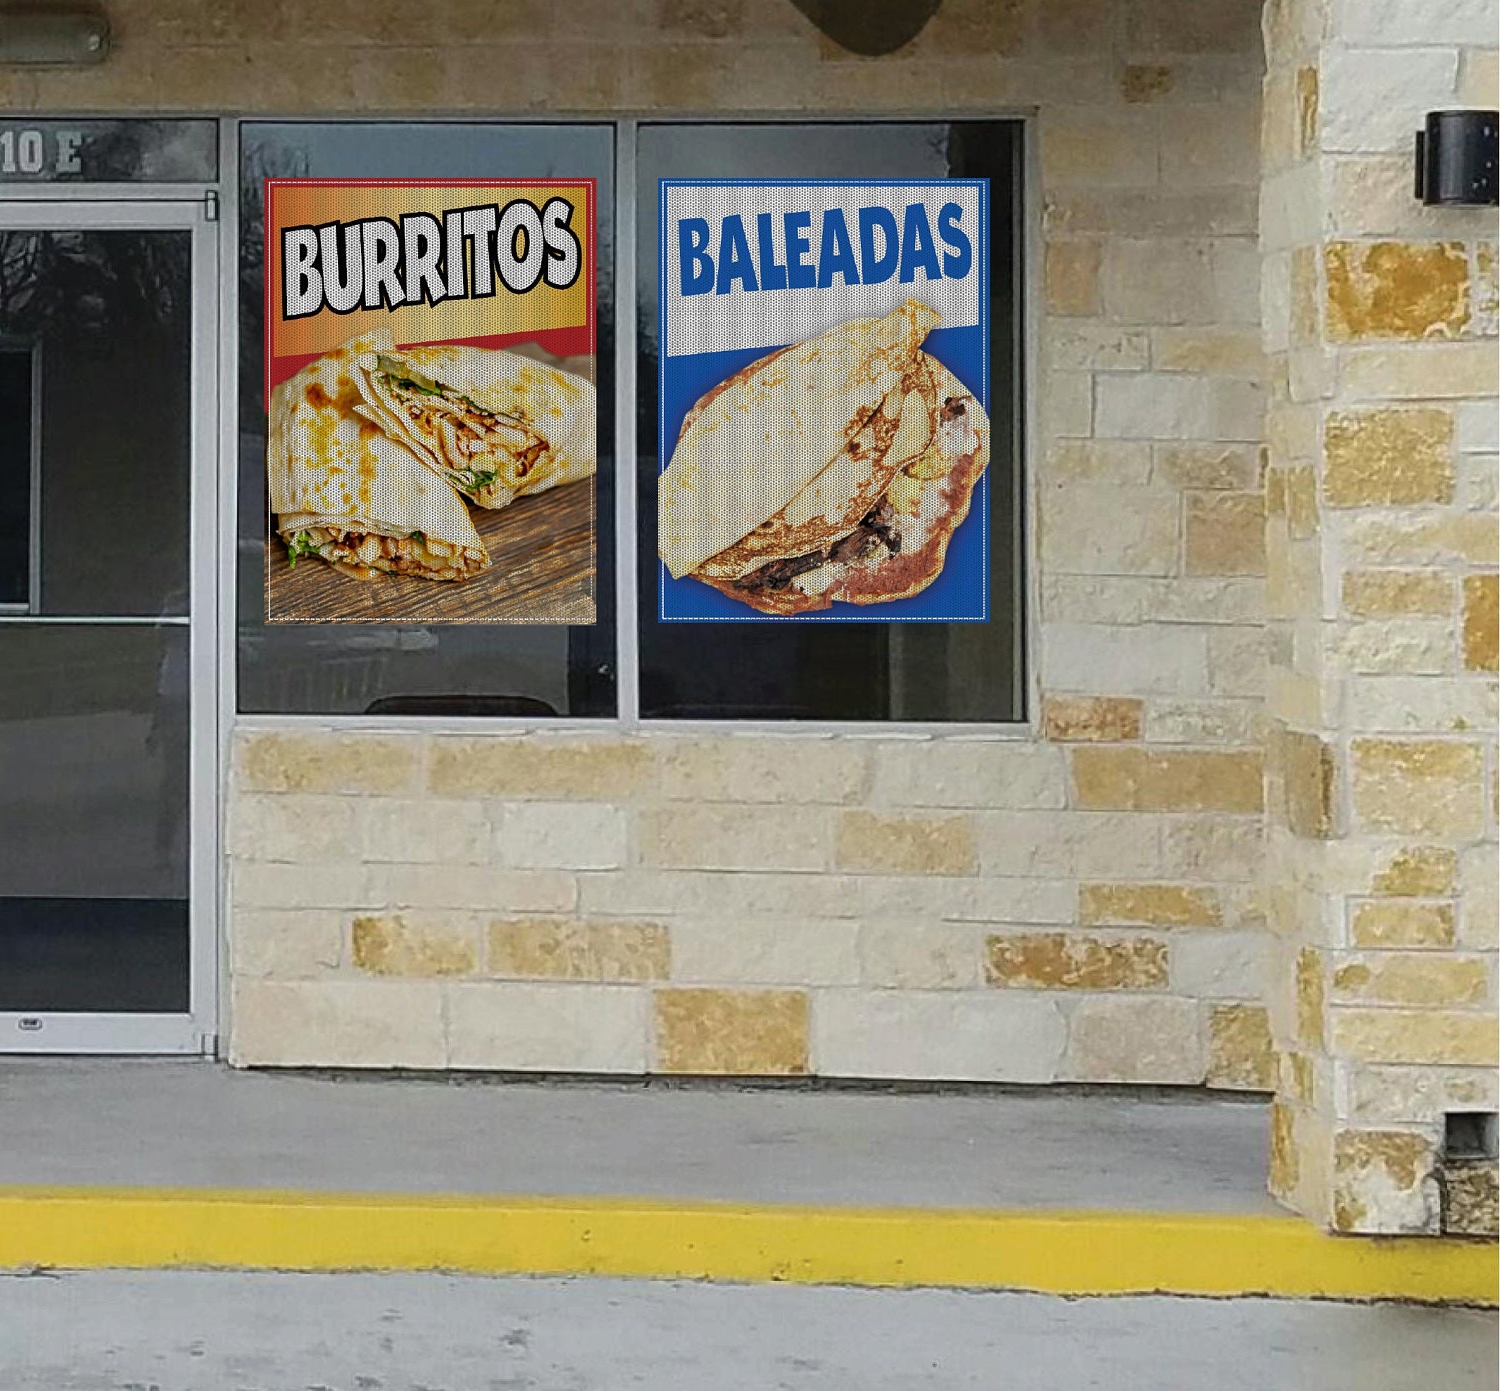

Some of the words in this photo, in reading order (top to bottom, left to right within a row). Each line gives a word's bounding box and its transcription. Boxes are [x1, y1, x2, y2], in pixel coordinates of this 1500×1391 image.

[55, 130, 82, 174] E
[281, 197, 582, 321] BURRITOS
[679, 202, 972, 296] BALEADAS
